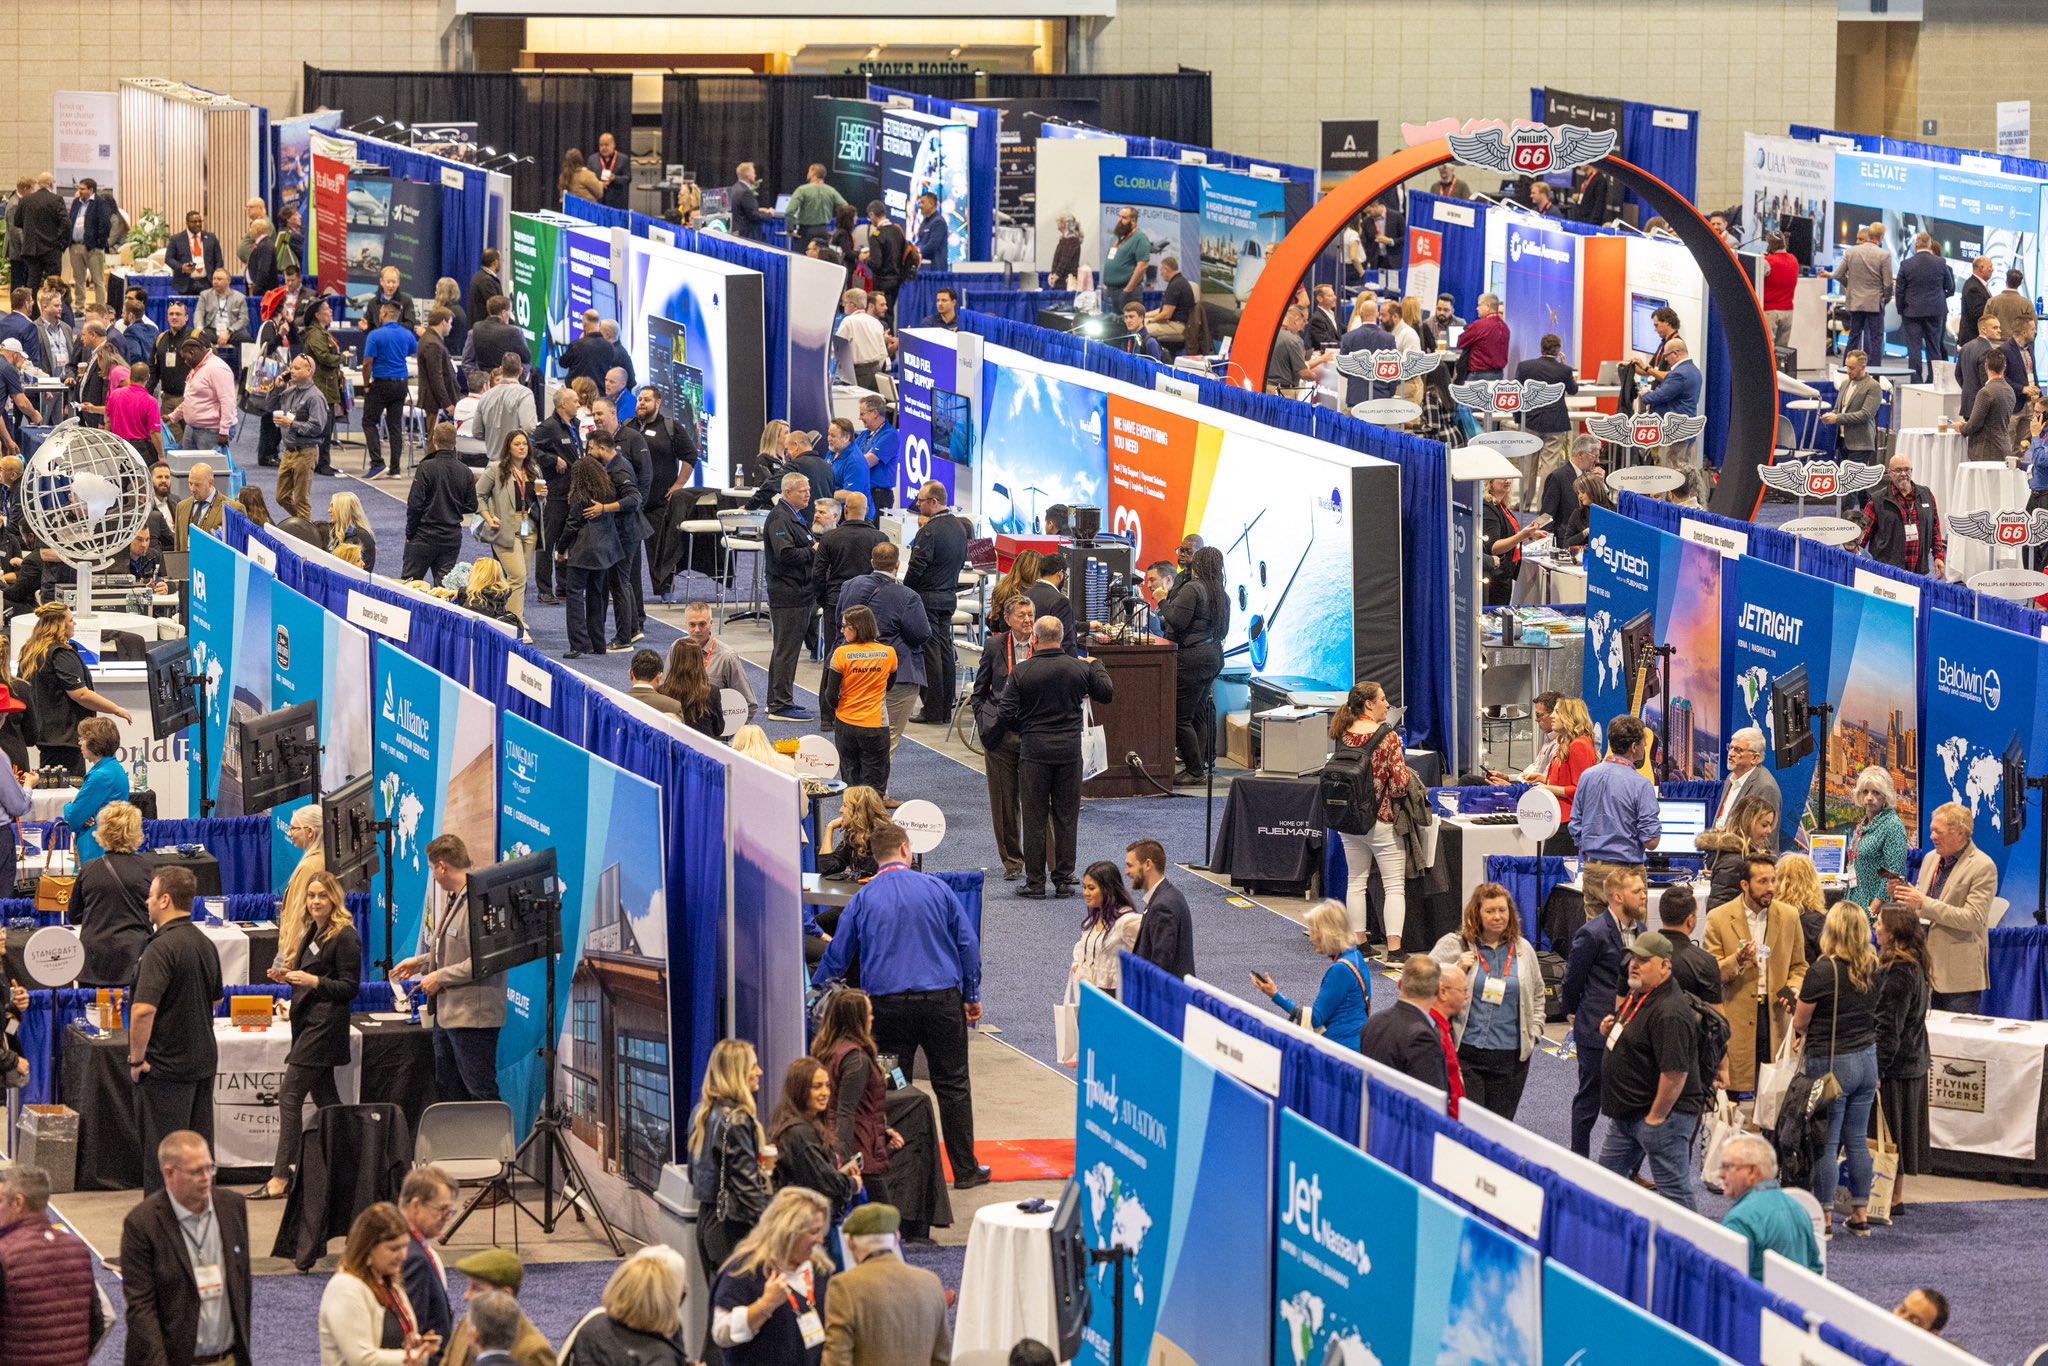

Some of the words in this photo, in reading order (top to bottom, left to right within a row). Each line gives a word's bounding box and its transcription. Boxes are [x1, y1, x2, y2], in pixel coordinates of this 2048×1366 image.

[1517, 134, 1548, 144] PHILLIPS
[1518, 148, 1546, 165] 66
[1861, 161, 1907, 183] ELEVATE
[516, 290, 530, 327] GO
[1379, 364, 1397, 375] 66
[1498, 395, 1516, 406] 66
[1637, 428, 1657, 441] 66
[905, 433, 931, 488] GO
[1811, 467, 1834, 475] PHILLIPS
[1811, 477, 1832, 490] 66
[2001, 516, 2025, 524] PHILLIPS
[2001, 526, 2023, 539] 66
[1603, 546, 1648, 579] syntech
[1738, 602, 1803, 646] JETRIGHT
[847, 652, 868, 660] GENERAL
[1938, 656, 1983, 695] Baldwin
[1938, 684, 1950, 695] safety
[1959, 691, 1982, 703] compliance
[723, 708, 747, 716] ETASIA
[396, 696, 430, 743] Alliance
[115, 736, 170, 763] orld
[1520, 809, 1544, 818] Baldwin
[1936, 1078, 1980, 1091] FLYING
[1935, 1088, 1979, 1101] TIGERS
[233, 1112, 254, 1122] JET
[256, 1114, 280, 1124] CEN
[1120, 1099, 1168, 1150] AVIATION
[1281, 1160, 1323, 1244] Jet
[1321, 1218, 1359, 1268] Nassau
